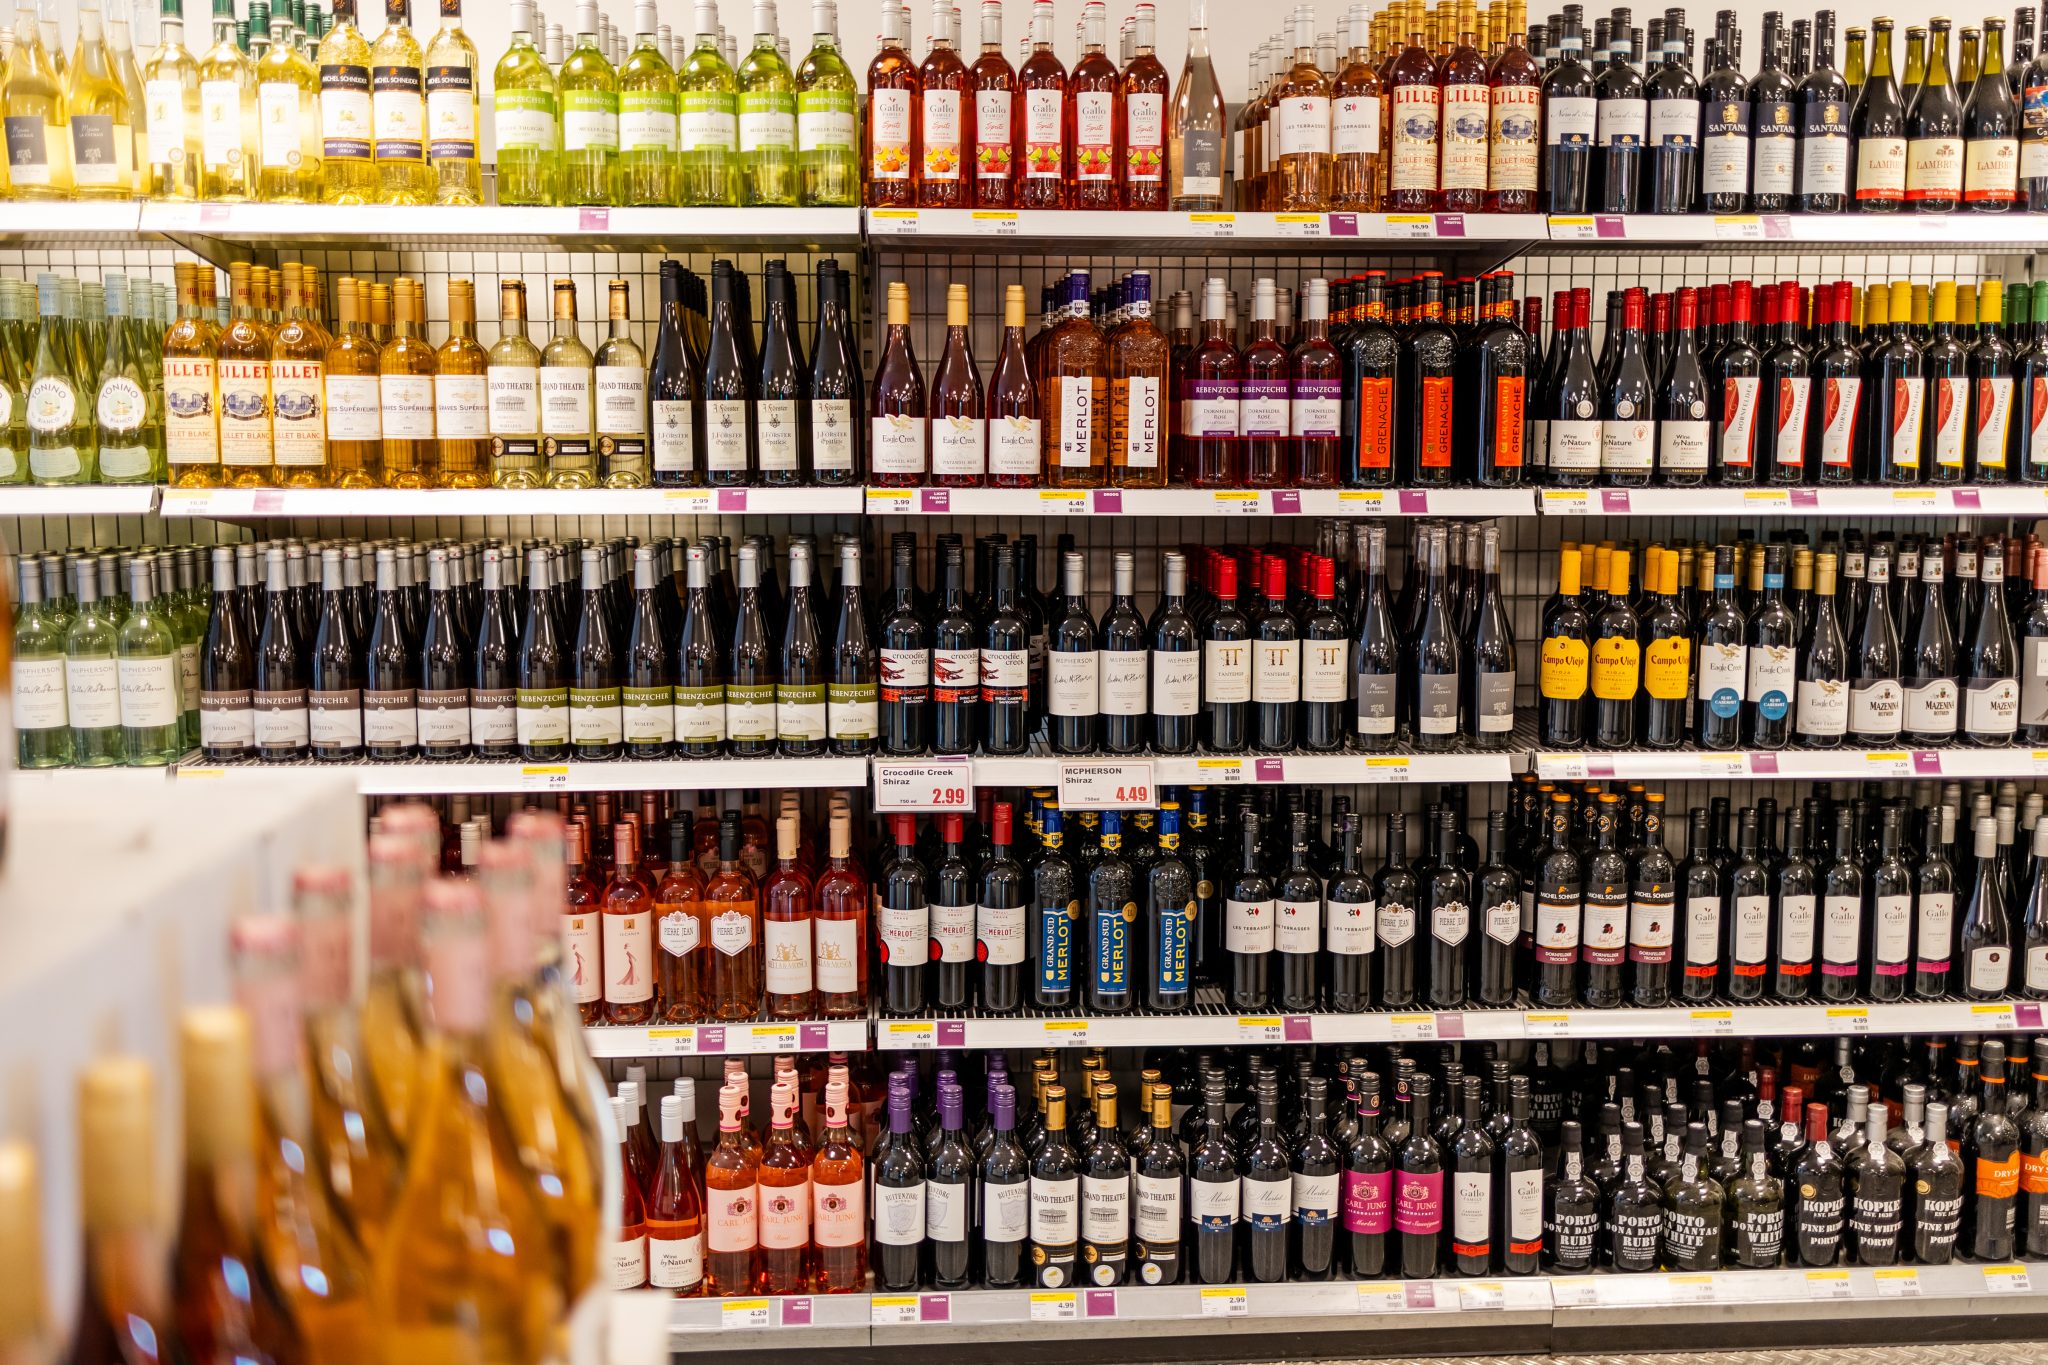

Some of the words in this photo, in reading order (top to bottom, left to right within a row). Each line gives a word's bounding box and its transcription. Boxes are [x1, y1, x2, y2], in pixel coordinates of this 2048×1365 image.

[879, 103, 904, 112] Gallo
[929, 103, 954, 112] Gallo
[982, 105, 1007, 114] Gallo
[1032, 104, 1057, 113] Gallo
[1082, 106, 1107, 115] Gallo
[1132, 108, 1157, 117] Gallo
[1708, 124, 1747, 133] SANTANA
[1809, 124, 1847, 133] SANTANA
[1495, 157, 1517, 165] LILLET
[220, 364, 269, 379] LILLET
[504, 382, 532, 391] THEATRE
[557, 382, 585, 391] THEATRE
[617, 382, 642, 391] THEATRE
[32, 384, 66, 400] TONINO
[102, 384, 138, 400] TONINO
[1738, 384, 1753, 431] DORNFELDER
[1793, 384, 1806, 431] DORNFELDER
[1951, 385, 1964, 431] DORNFELDER
[1076, 386, 1087, 453] MERLOT
[1145, 386, 1155, 453] MERLOT
[1378, 387, 1387, 454] GRENACHE
[1440, 387, 1449, 453] GRENACHE
[1512, 387, 1521, 453] GRENACHE
[247, 432, 270, 440] BLANC
[882, 435, 898, 443] Eagle
[899, 435, 915, 443] Creek
[943, 436, 959, 445] Eagle
[959, 436, 976, 444] Creek
[1002, 436, 1017, 445] Eagle
[1018, 436, 1033, 444] Creek
[988, 652, 1020, 660] crocodile
[1544, 654, 1564, 666] Campo
[1565, 656, 1584, 666] Viejo
[1595, 654, 1619, 666] Campo
[1620, 656, 1636, 665] Viejo
[1651, 655, 1676, 666] Campo
[1710, 663, 1726, 672] Eagle
[1728, 663, 1742, 671] Creek
[1759, 665, 1776, 674] Eagle
[418, 696, 467, 704] REBENZECHER
[932, 788, 965, 804] 2.99
[1116, 786, 1147, 802] 4.49
[1695, 913, 1716, 921] Gallo
[1743, 912, 1766, 921] Gallo
[1789, 911, 1811, 920] Gallo
[1831, 912, 1854, 921] Gallo
[1885, 911, 1907, 920] Gallo
[1926, 909, 1949, 918] Gallo
[1380, 917, 1397, 927] PIERRE
[1398, 918, 1409, 927] JEAN
[1439, 917, 1454, 926] PIERRE
[1494, 917, 1508, 926] PIERRE
[664, 927, 679, 936] PIERRE
[681, 926, 694, 936] JEAN
[717, 927, 733, 936] PIERRE
[734, 926, 747, 935] JEAN
[943, 926, 966, 934] MERLOT
[1058, 917, 1069, 981] MERLOT
[1101, 938, 1109, 969] GRAND
[1113, 919, 1124, 983] MERLOT
[1164, 937, 1172, 968] GRAND
[1174, 918, 1186, 982] MERLOT
[2025, 1163, 2043, 1173] DRY
[1303, 1186, 1329, 1196] Merlot
[1460, 1189, 1484, 1198] Gallo
[1517, 1187, 1540, 1196] Gallo
[1032, 1193, 1049, 1203] GRAND
[1050, 1194, 1075, 1203] THEATRE
[1101, 1193, 1126, 1202] THEATRE
[1150, 1192, 1176, 1201] THEATRE
[1208, 1193, 1232, 1204] Merlot
[1345, 1198, 1364, 1208] CARL
[1366, 1201, 1387, 1209] JUNG
[1416, 1201, 1437, 1209] JUNG
[1803, 1198, 1844, 1213] KOPKE
[1854, 1198, 1900, 1213] KOPKE
[718, 1217, 739, 1227] CARL
[761, 1215, 781, 1225] CARL
[783, 1214, 805, 1224] JUNG
[835, 1212, 856, 1223] JUNG
[1555, 1213, 1597, 1226] PORTO
[1618, 1214, 1660, 1227] PORTO
[1664, 1208, 1704, 1227] PORTO
[1353, 1219, 1377, 1227] Merlot
[1543, 1221, 1572, 1235] DONA
[1732, 1220, 1761, 1232] DONA
[1801, 1223, 1825, 1233] FINE
[1850, 1219, 1871, 1232] FINE
[1873, 1221, 1902, 1233] WHITE
[1917, 1220, 1942, 1231] FINE
[1606, 1222, 1635, 1236] DONA
[1676, 1223, 1718, 1236] DANTAS
[1560, 1234, 1593, 1246] RUBY
[1623, 1235, 1657, 1247] RUBY
[1664, 1228, 1704, 1247] WHITE
[1811, 1235, 1839, 1245] PORTO
[1860, 1236, 1893, 1246] PORTO
[1930, 1234, 1957, 1244] PORTO
[617, 1258, 641, 1269] Nature
[660, 1259, 668, 1267] by
[668, 1257, 693, 1266] Nature
[750, 1309, 767, 1317] 4.29
